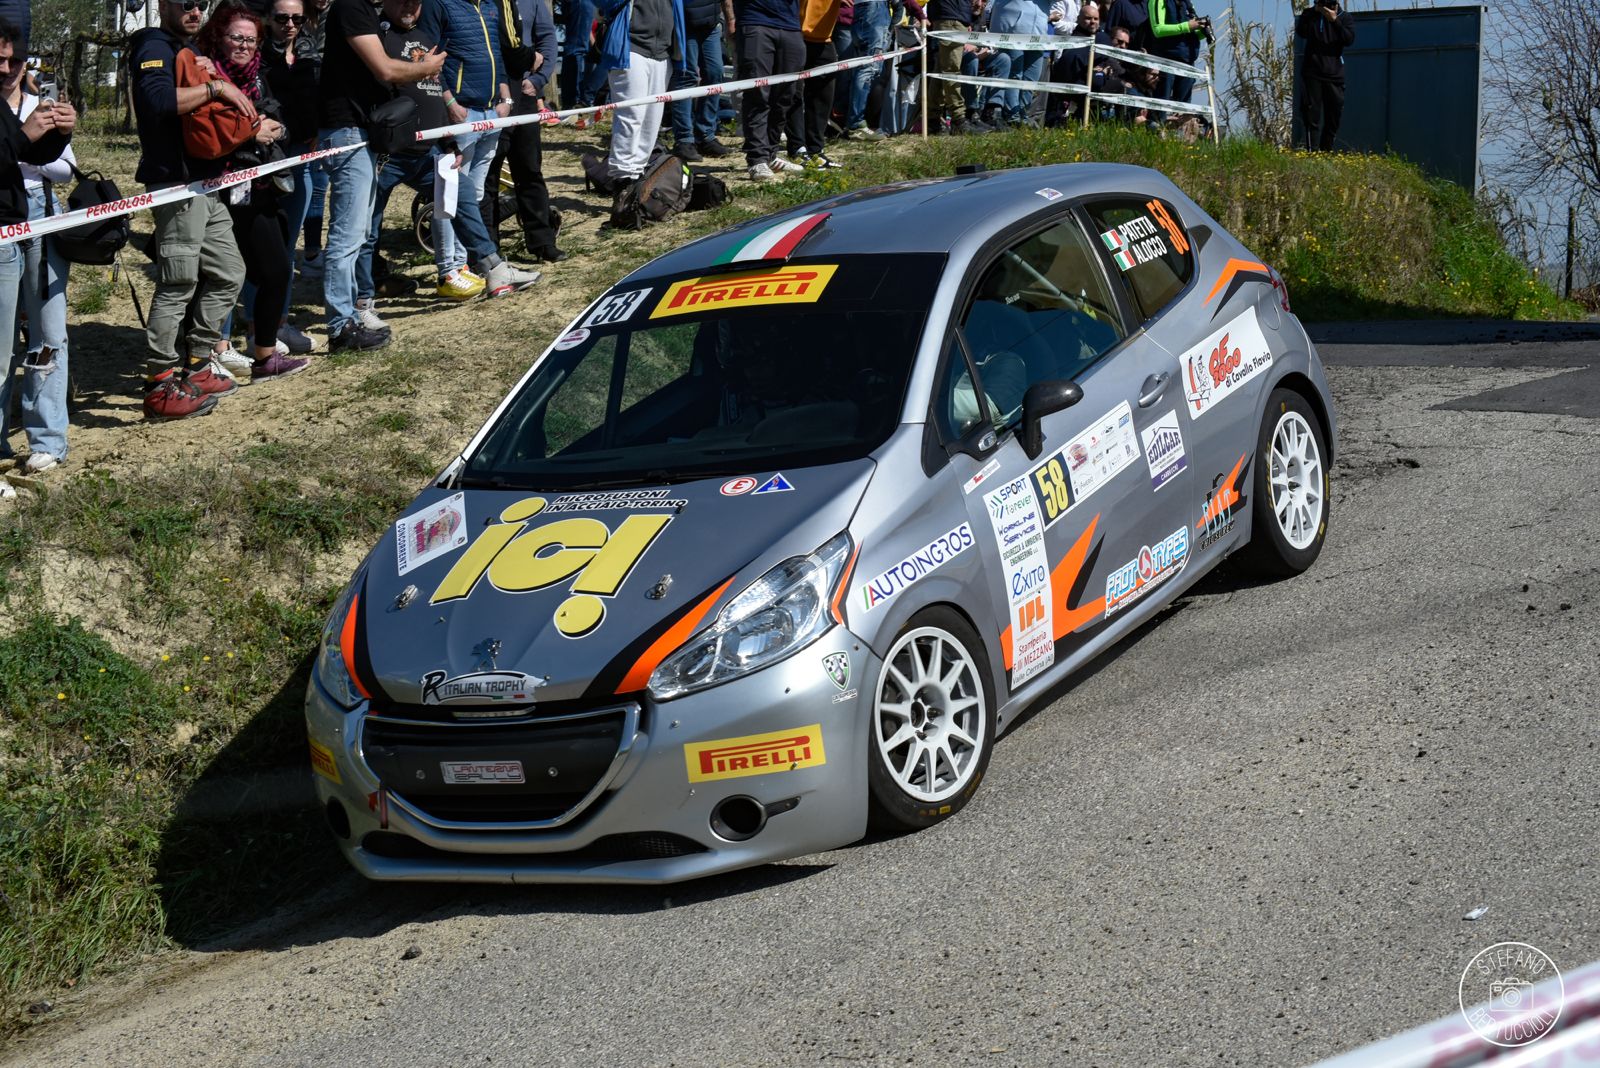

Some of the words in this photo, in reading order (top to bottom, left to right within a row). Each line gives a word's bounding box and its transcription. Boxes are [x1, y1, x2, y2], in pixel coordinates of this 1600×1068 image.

[471, 121, 495, 132] ZONA
[201, 167, 260, 191] PERICOLOSA
[86, 193, 155, 218] PERICOLOSA
[1118, 215, 1158, 243] PATETTA
[1146, 199, 1190, 255] 58
[1132, 235, 1168, 264] ALOCCO
[667, 271, 818, 309] PIRELLI
[590, 290, 642, 325] 58
[1232, 364, 1254, 383] Cavallo
[1252, 351, 1271, 369] Flavio
[1148, 432, 1181, 464] EDILCAR
[554, 489, 670, 504] MICROFUSIONI
[999, 478, 1027, 501] SPORT
[1035, 458, 1069, 519] 58
[544, 503, 564, 513] IN
[397, 522, 408, 571] CONCORRENTE
[870, 525, 973, 607] AUTOINGROS
[1024, 640, 1053, 668] MEZZANO
[422, 670, 447, 704] R
[444, 682, 482, 696] ITALIAN
[485, 679, 527, 693] TROPHY
[698, 735, 811, 775] PIRELLI
